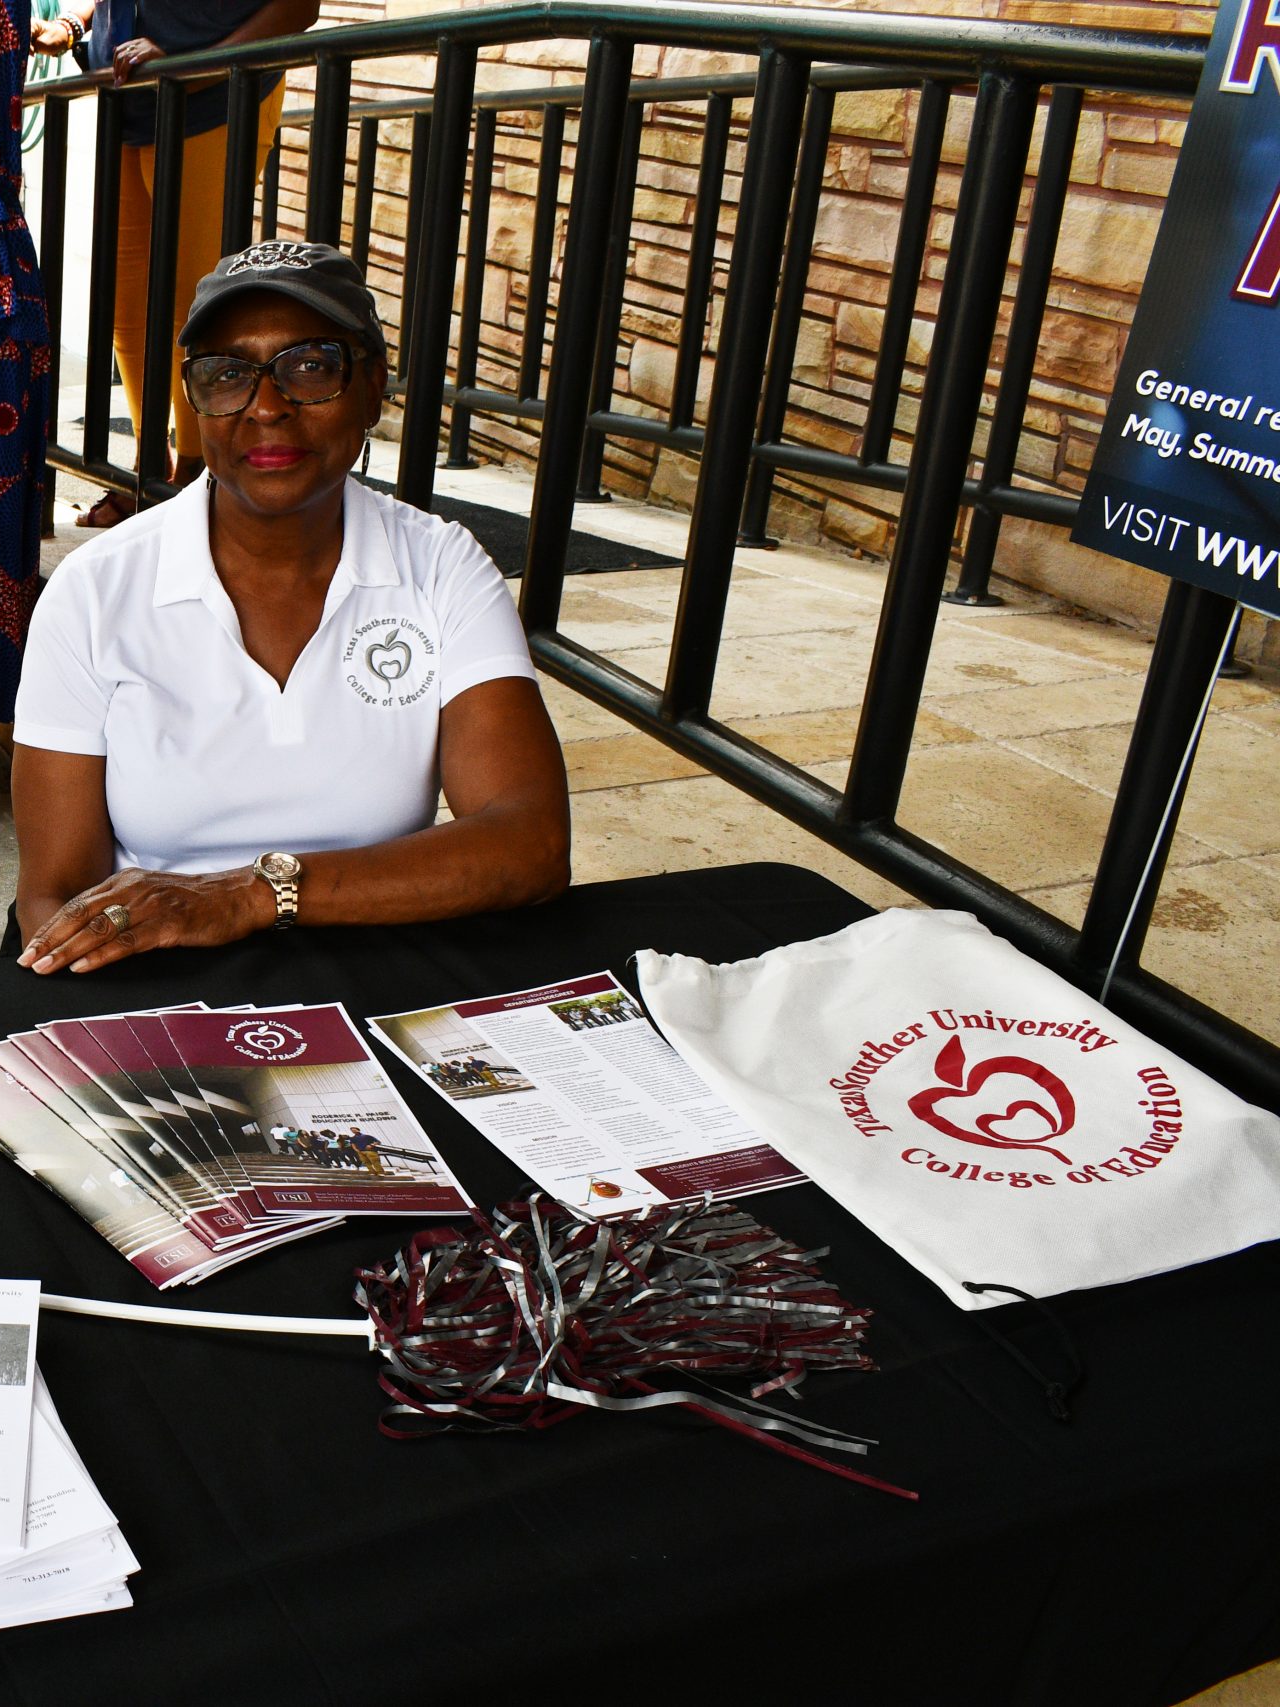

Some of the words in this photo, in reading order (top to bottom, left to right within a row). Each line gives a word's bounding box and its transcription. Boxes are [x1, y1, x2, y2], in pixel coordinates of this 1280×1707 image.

[1135, 369, 1252, 421] General
[1121, 413, 1181, 458] May,
[1104, 495, 1190, 551] VISIT
[343, 637, 358, 662] Texas
[355, 618, 397, 637] Southern
[400, 618, 435, 654] University
[347, 674, 377, 704] College
[382, 698, 393, 706] of
[398, 670, 435, 706] Education
[927, 1008, 1118, 1053] University
[901, 1148, 1056, 1188] College
[1068, 1164, 1108, 1185] of
[1103, 1066, 1182, 1179] Education
